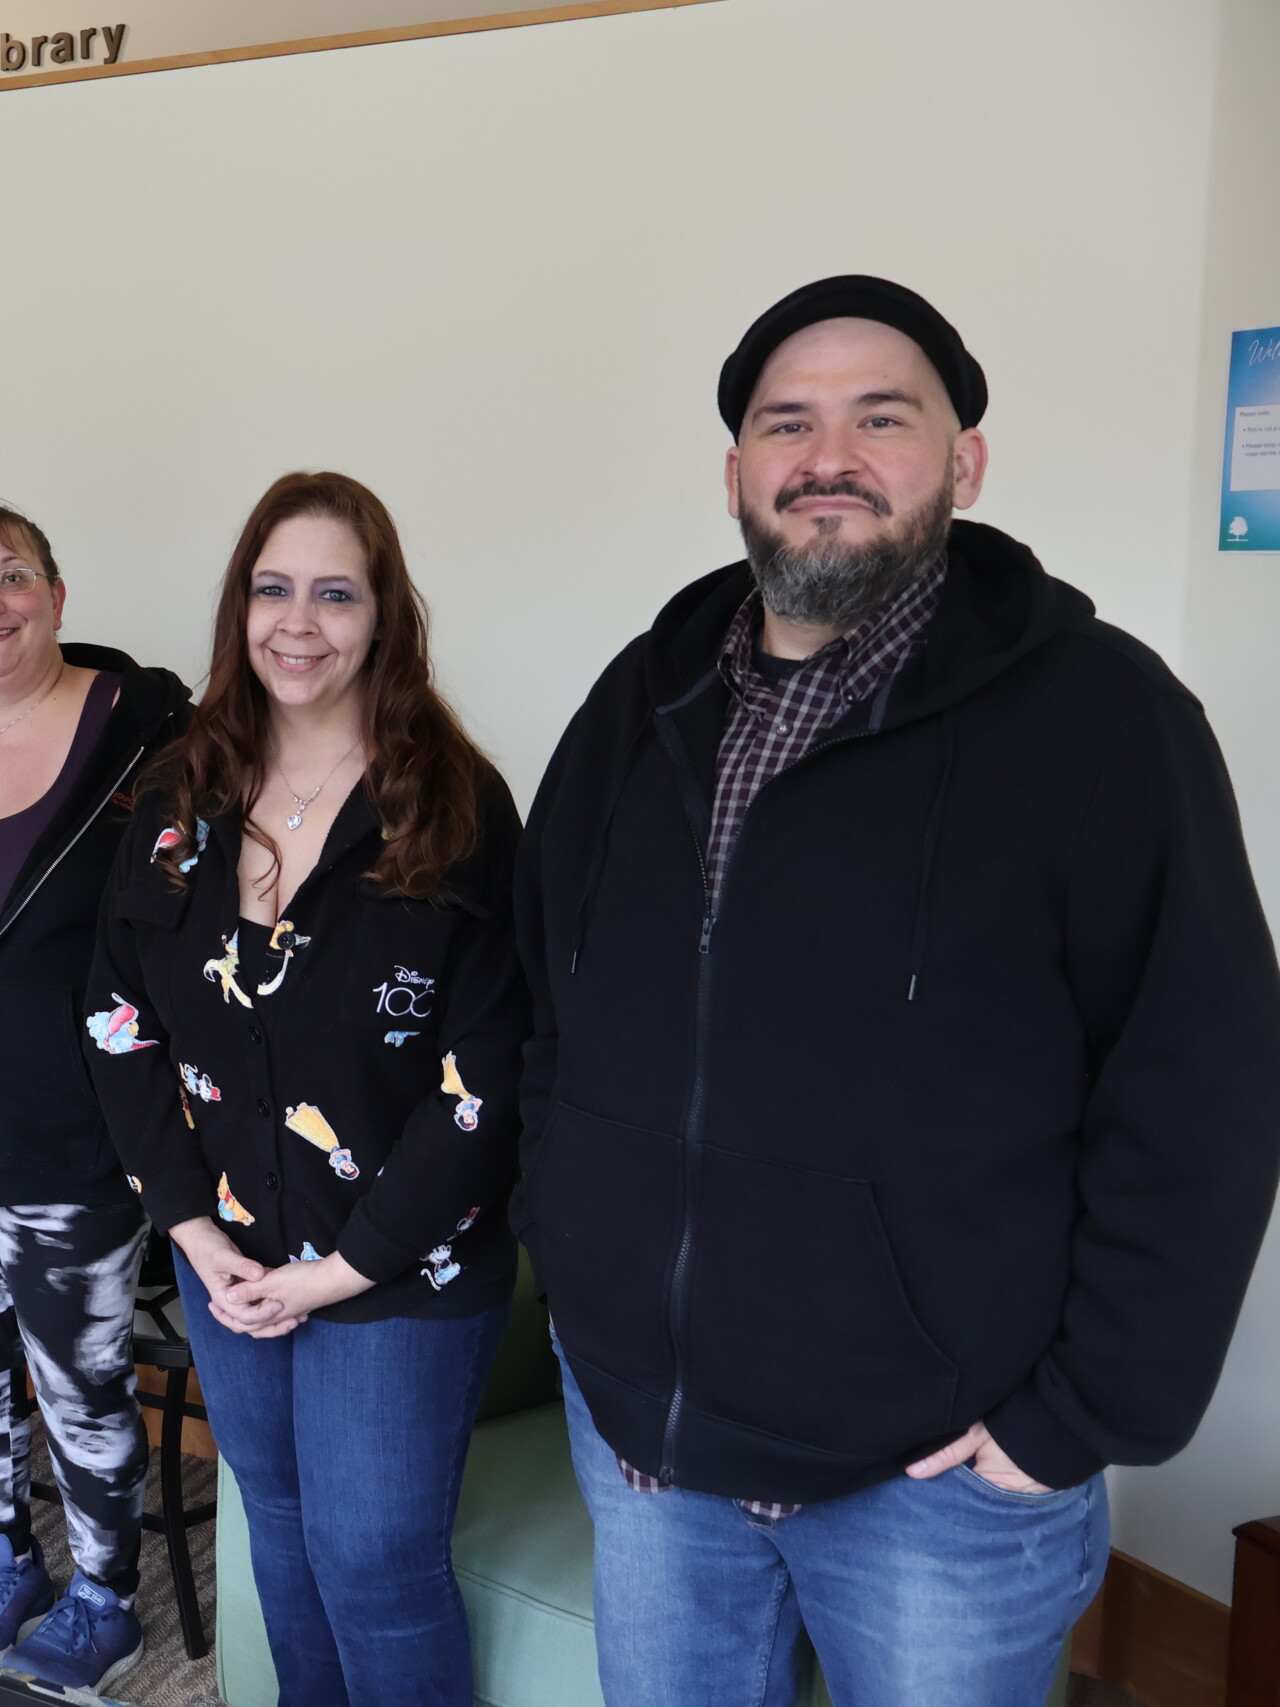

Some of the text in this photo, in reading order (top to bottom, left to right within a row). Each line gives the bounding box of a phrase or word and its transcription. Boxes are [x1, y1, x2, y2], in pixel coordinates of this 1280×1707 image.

[1248, 338, 1280, 367] Wel
[394, 965, 435, 990] Disney
[372, 982, 435, 1018] 100
